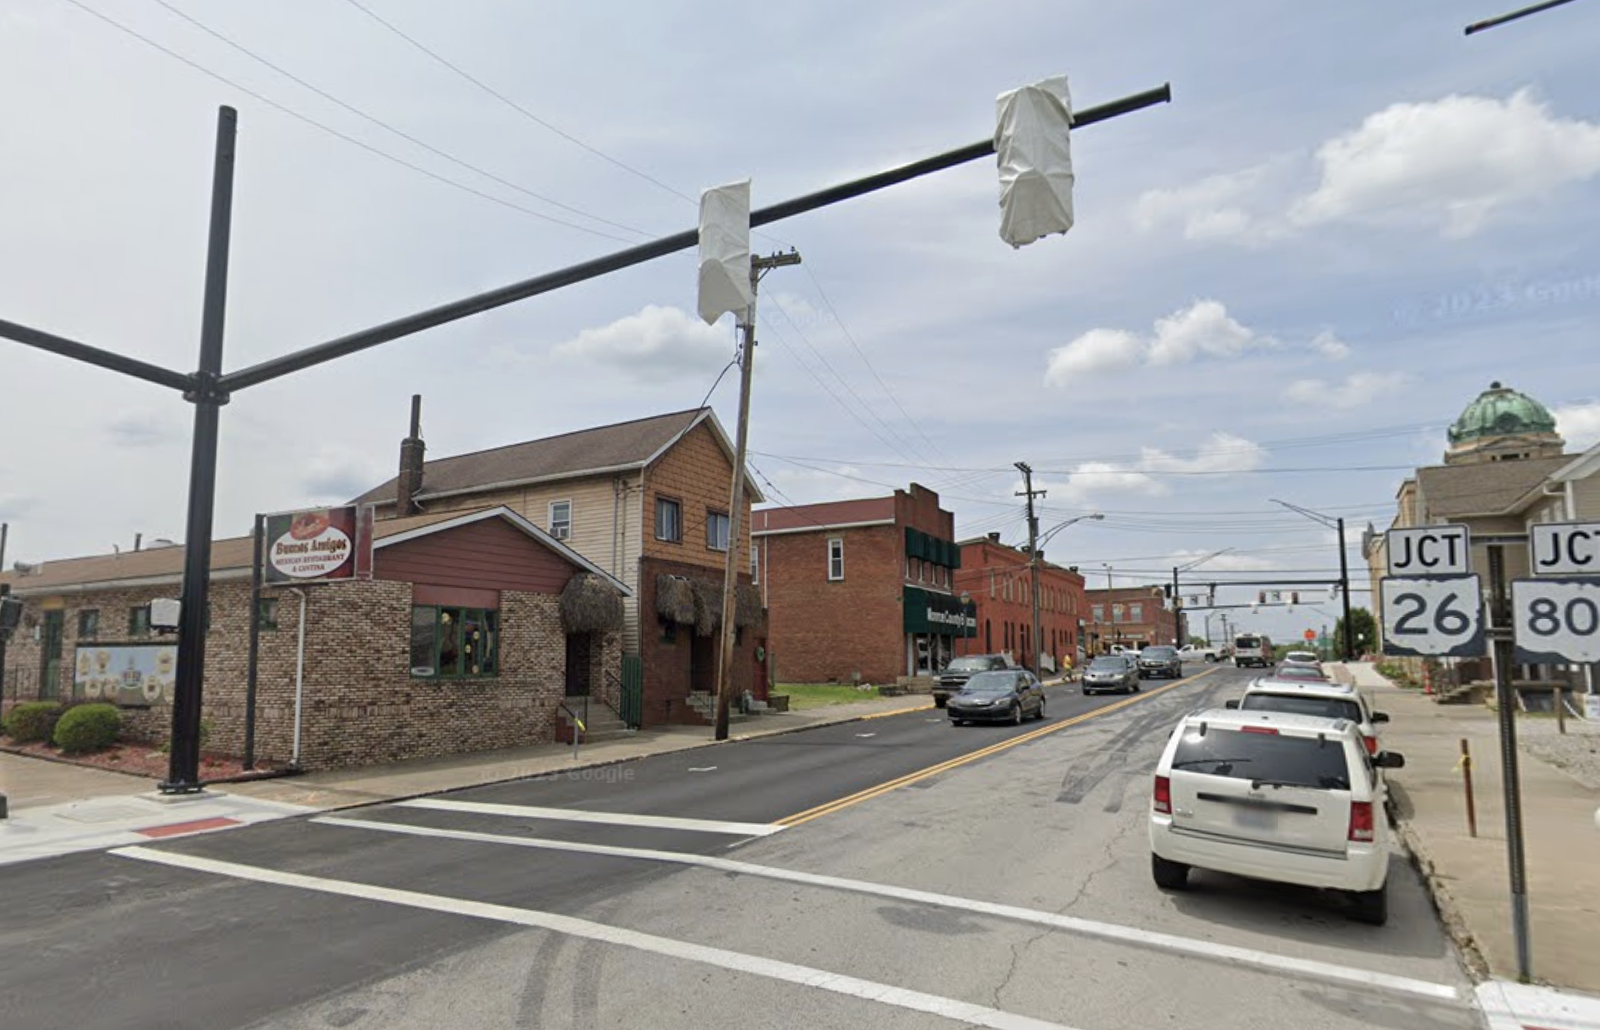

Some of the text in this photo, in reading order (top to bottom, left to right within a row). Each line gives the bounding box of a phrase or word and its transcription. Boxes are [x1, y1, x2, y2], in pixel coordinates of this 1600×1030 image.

[1393, 534, 1462, 568] JCT
[1539, 530, 1600, 566] JC
[1392, 592, 1470, 636] 26
